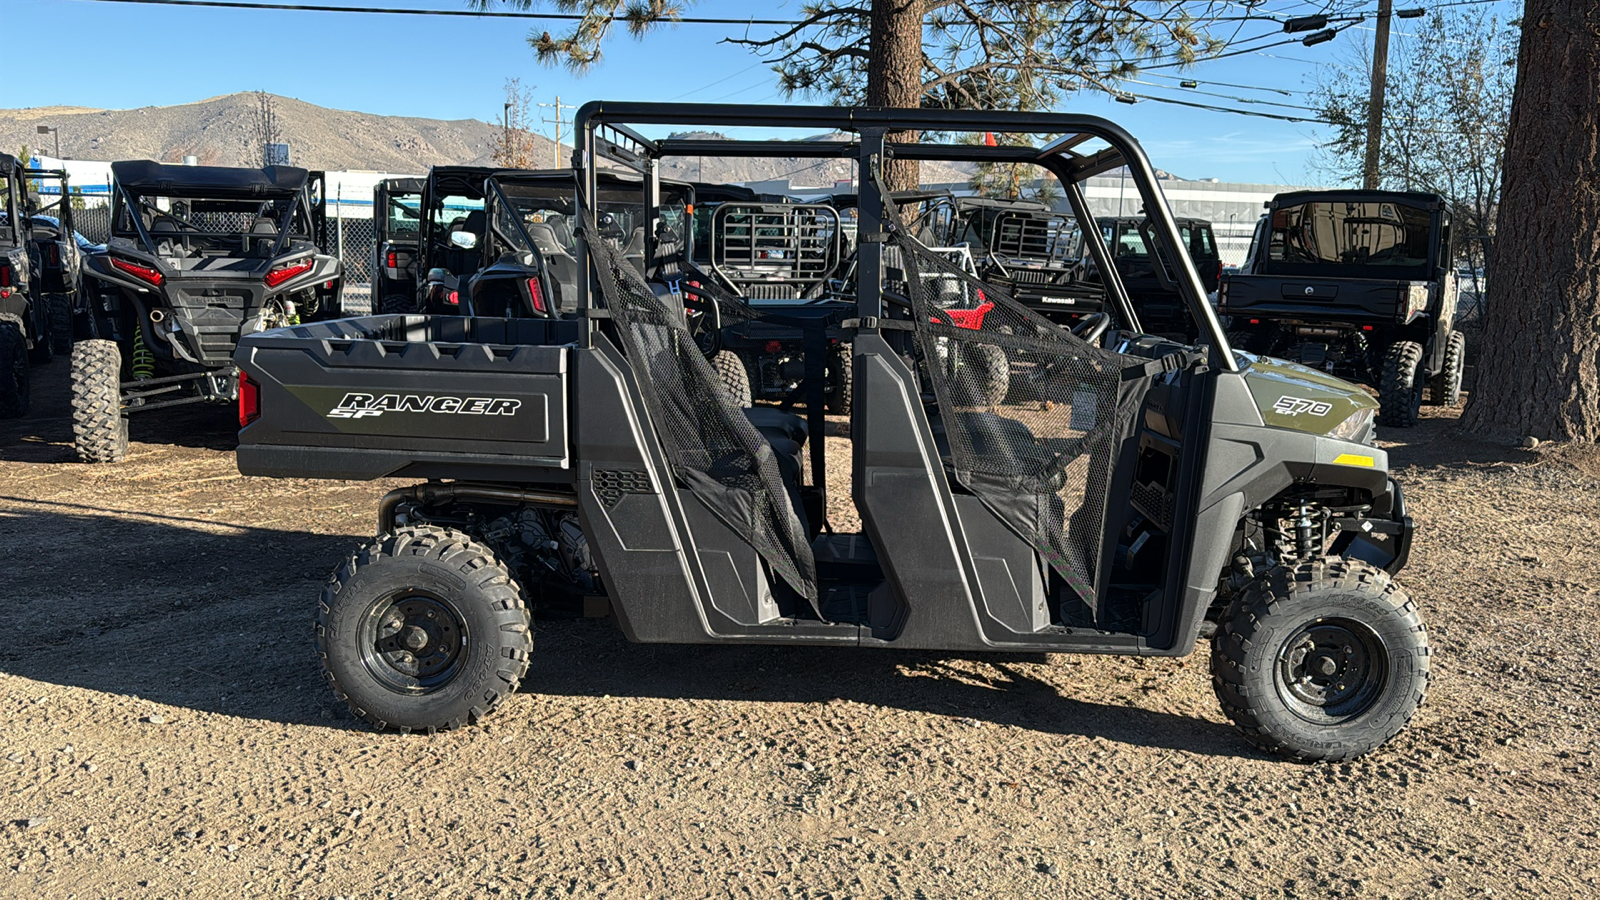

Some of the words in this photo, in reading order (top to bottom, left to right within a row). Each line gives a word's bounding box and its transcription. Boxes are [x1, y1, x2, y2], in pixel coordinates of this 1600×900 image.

[1041, 295, 1076, 305] Kawasaki
[337, 392, 522, 416] RANGER
[1273, 395, 1333, 417] 570
[326, 408, 385, 419] SP
